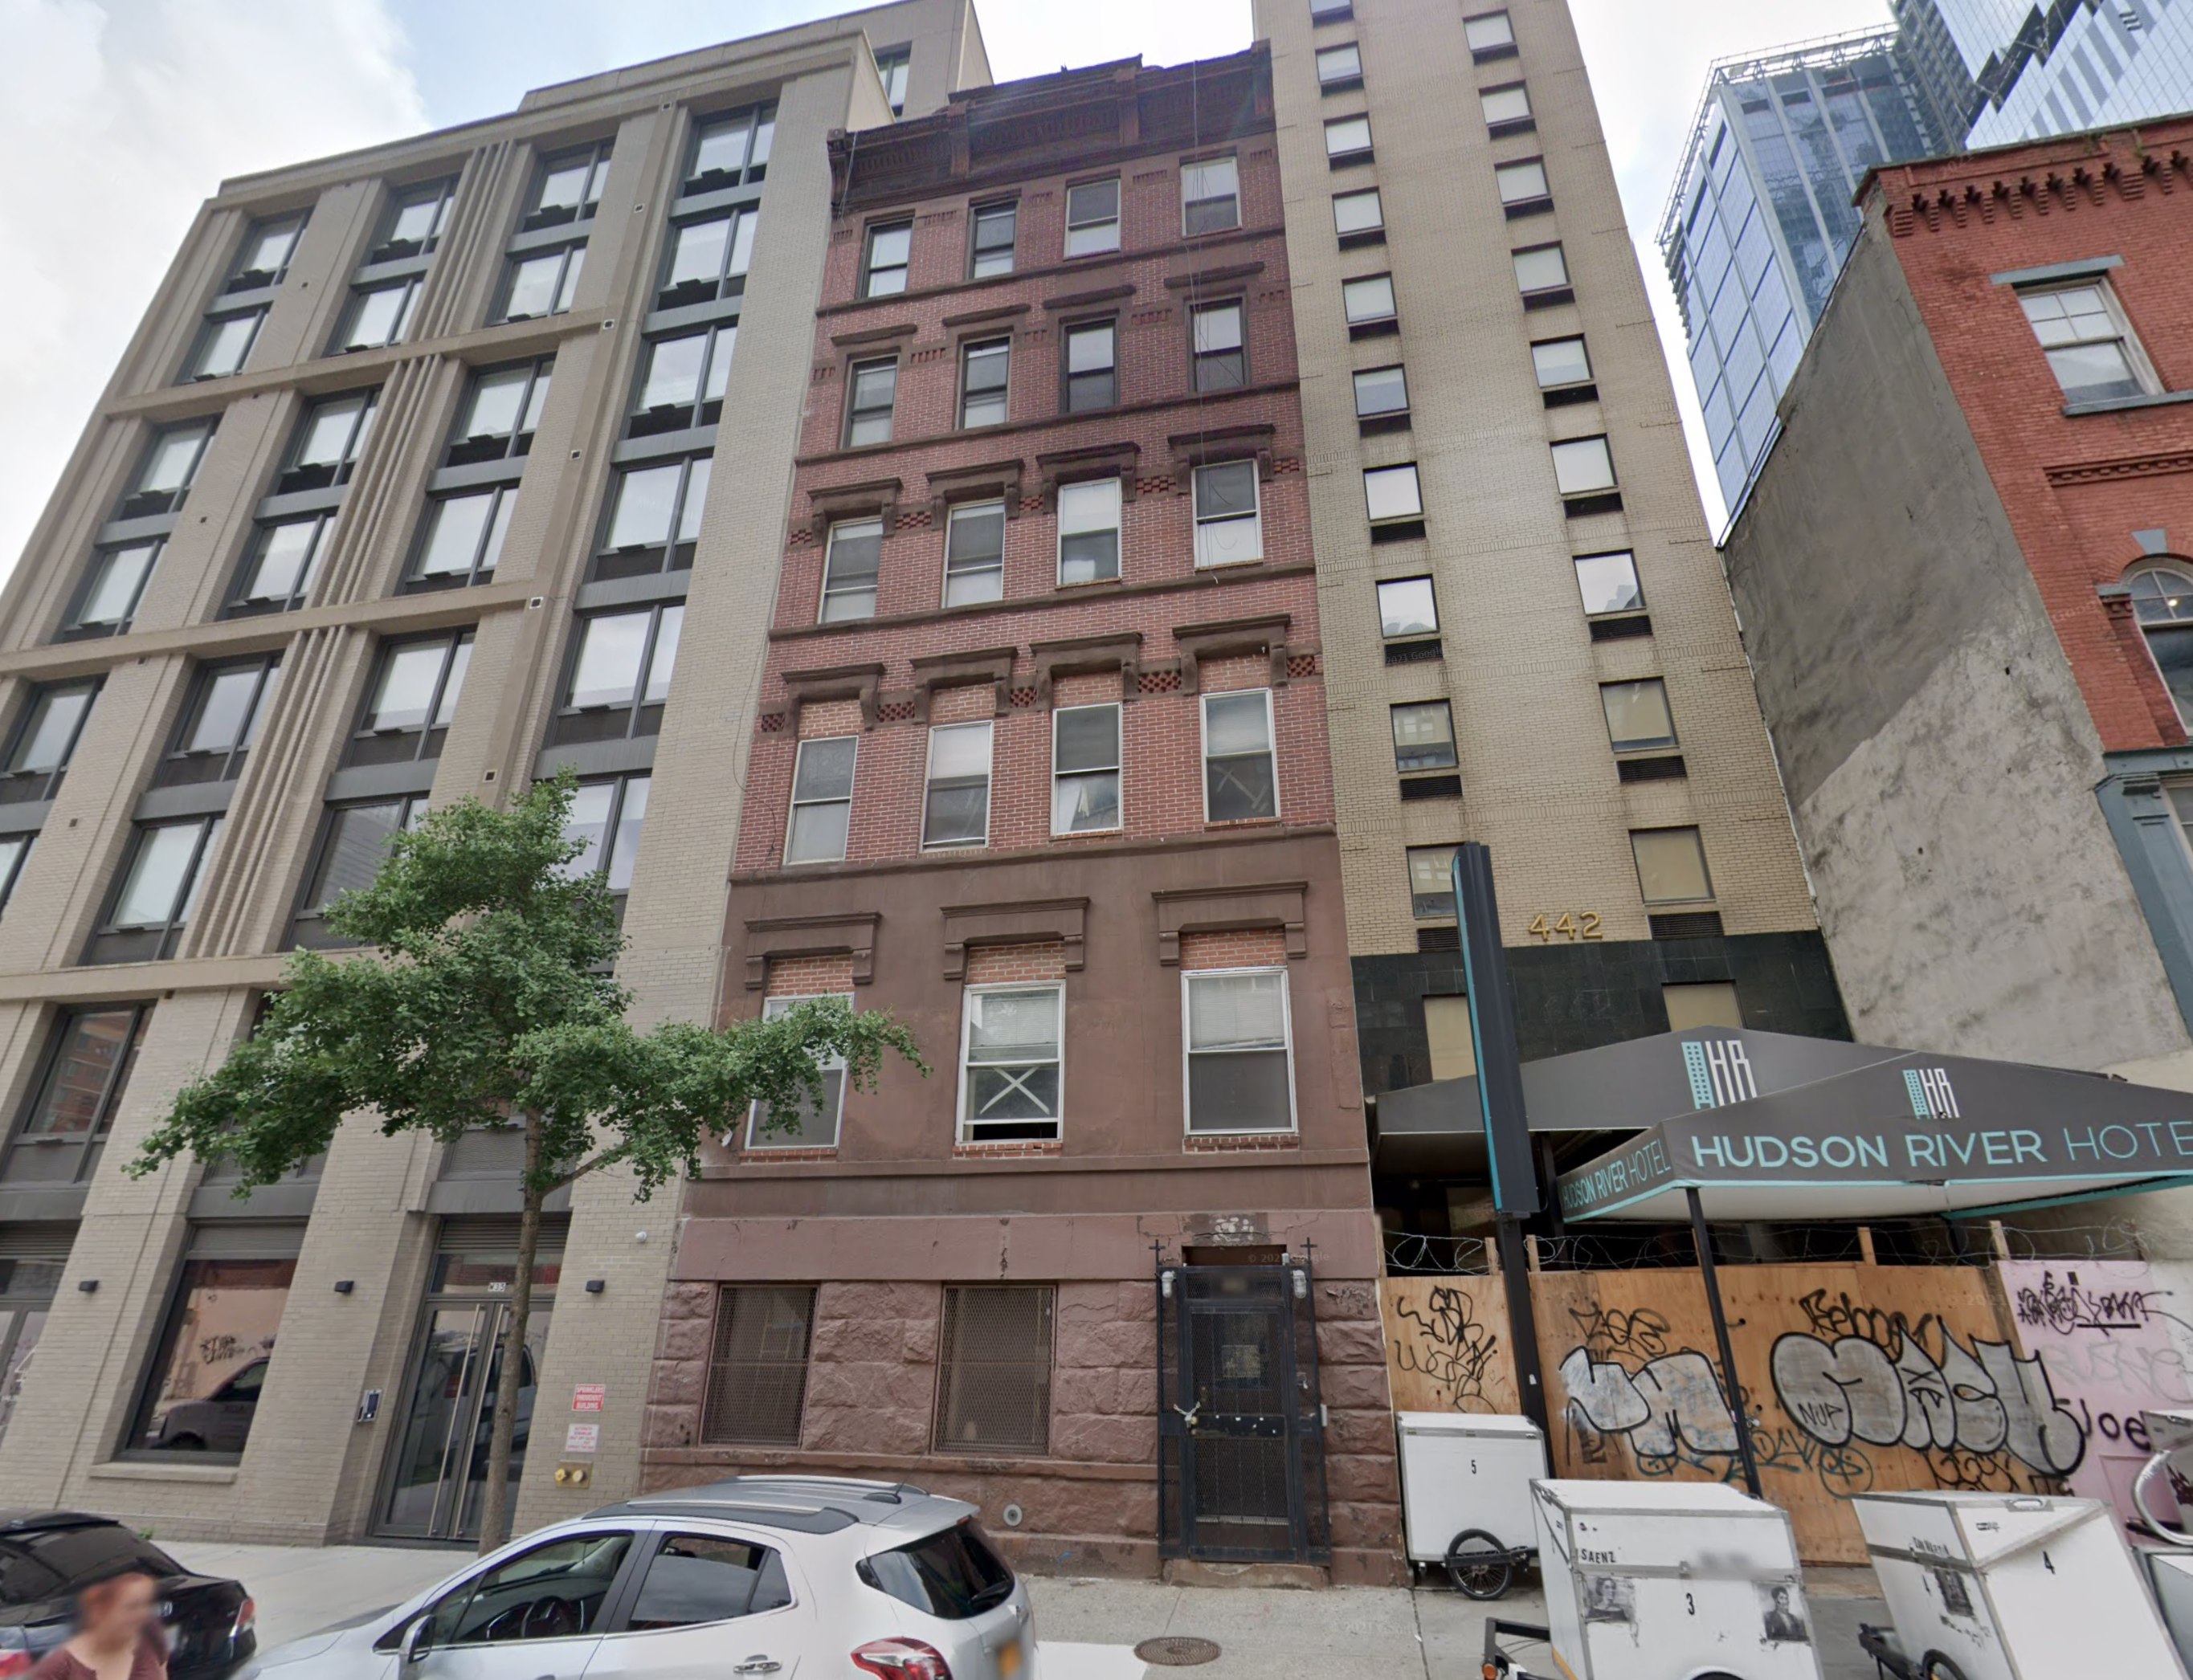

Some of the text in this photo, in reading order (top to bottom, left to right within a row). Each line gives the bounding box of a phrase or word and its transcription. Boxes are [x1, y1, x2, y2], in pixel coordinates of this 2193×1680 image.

[1527, 910, 1603, 942] 442
[1691, 1135, 1889, 1168] HUDSON
[1904, 1129, 2048, 1167] RIVER
[1562, 1138, 1672, 1209] HUDSON RIVER HOTEL
[1470, 1459, 1477, 1475] 5
[1581, 1547, 1616, 1564] SAENZ
[2043, 1550, 2056, 1575] 4
[1686, 1592, 1696, 1616] 3
